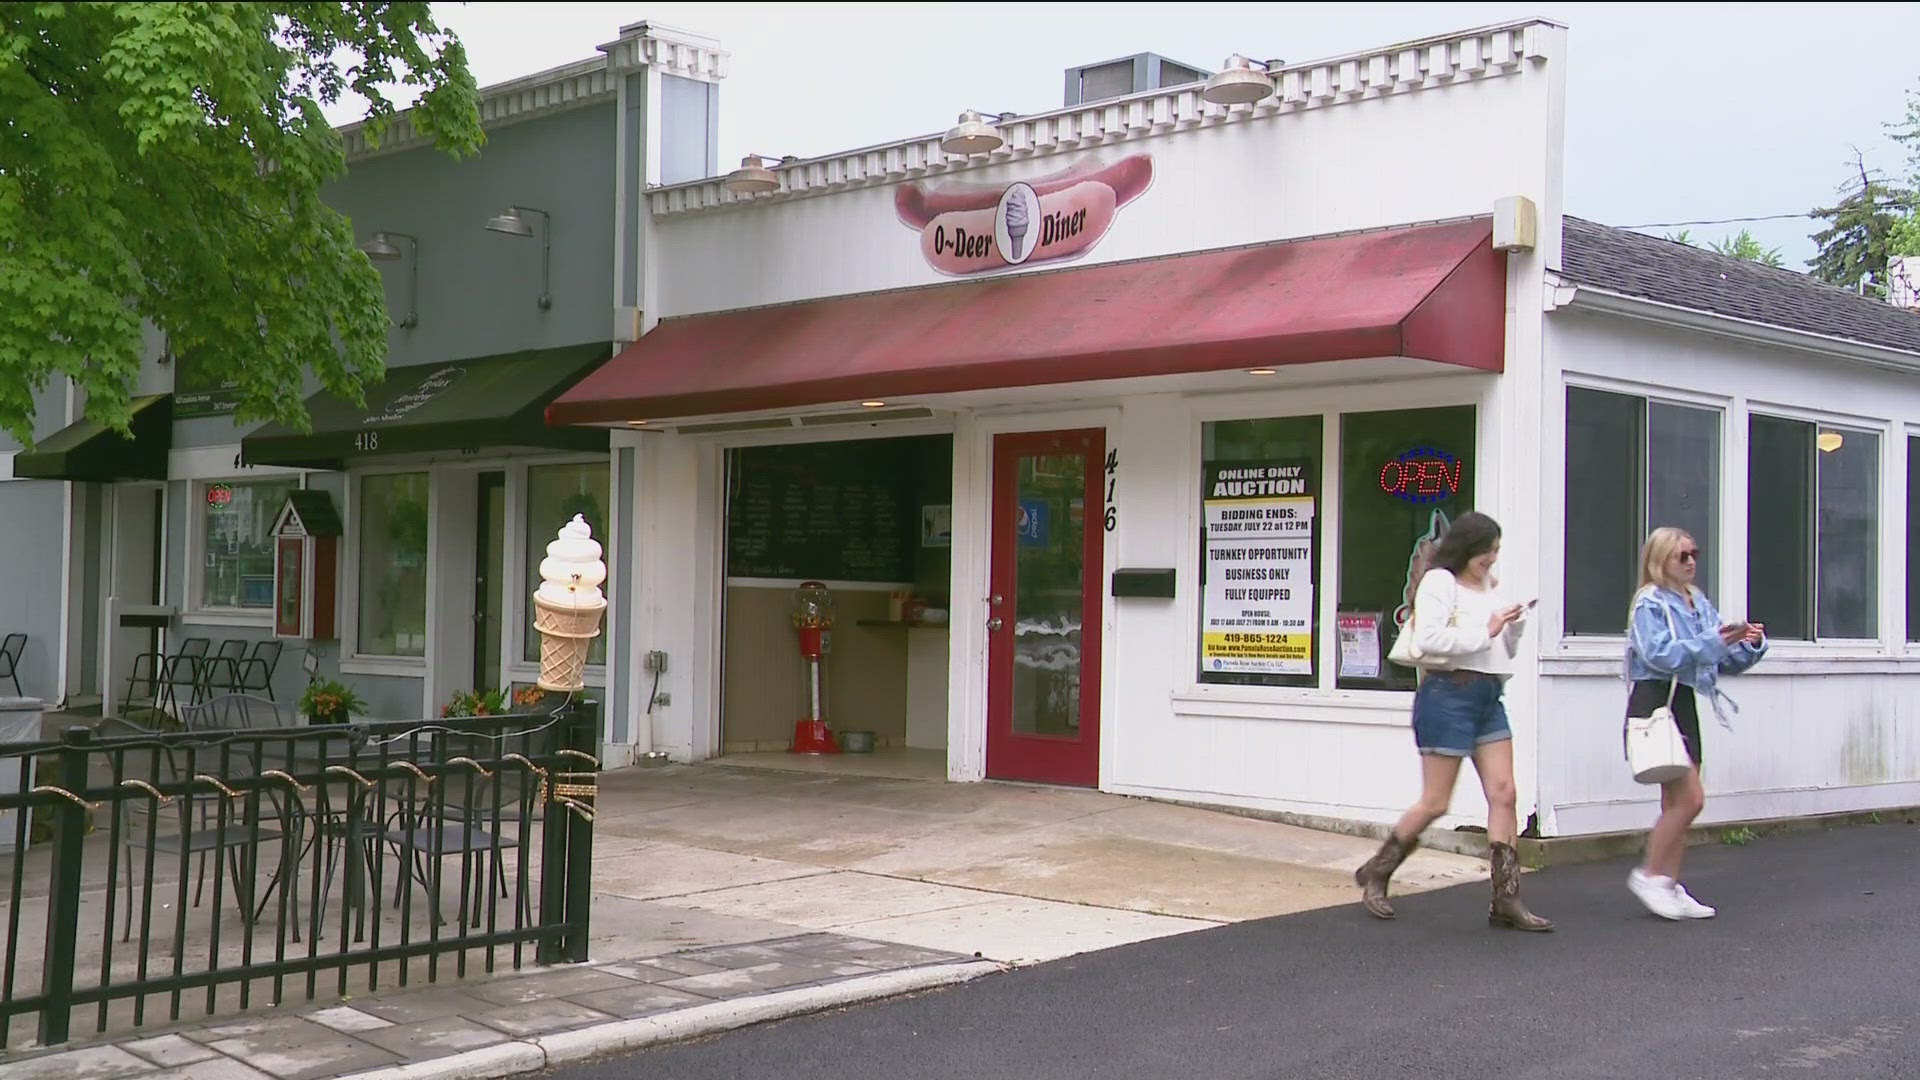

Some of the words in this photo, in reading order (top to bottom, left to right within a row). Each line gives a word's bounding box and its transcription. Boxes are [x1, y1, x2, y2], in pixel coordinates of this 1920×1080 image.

[1042, 207, 1087, 247] Diner
[354, 431, 378, 451] 418
[1218, 468, 1265, 480] ONLINE
[1267, 466, 1302, 478] ONLY
[1380, 460, 1462, 494] OPEN
[1213, 479, 1305, 497] AUCTION
[207, 489, 232, 503] OPEN
[1221, 509, 1263, 520] BIDDING
[1266, 508, 1297, 519] ENDS:
[1210, 523, 1243, 532] TUESDAY,
[1244, 522, 1261, 531] JULY
[1262, 522, 1273, 531] 22
[1274, 522, 1283, 530] at
[1285, 521, 1294, 530] 12
[1295, 521, 1308, 530] PM
[1210, 548, 1246, 560] TURNKEY
[1248, 547, 1308, 560] OPPORTUNITY
[1225, 568, 1267, 580] BUSINESS
[1269, 568, 1290, 580] ONLY
[1225, 588, 1247, 600] FULLY
[1248, 588, 1291, 601] EQUIPPED
[1223, 633, 1288, 643] 419-865-1224
